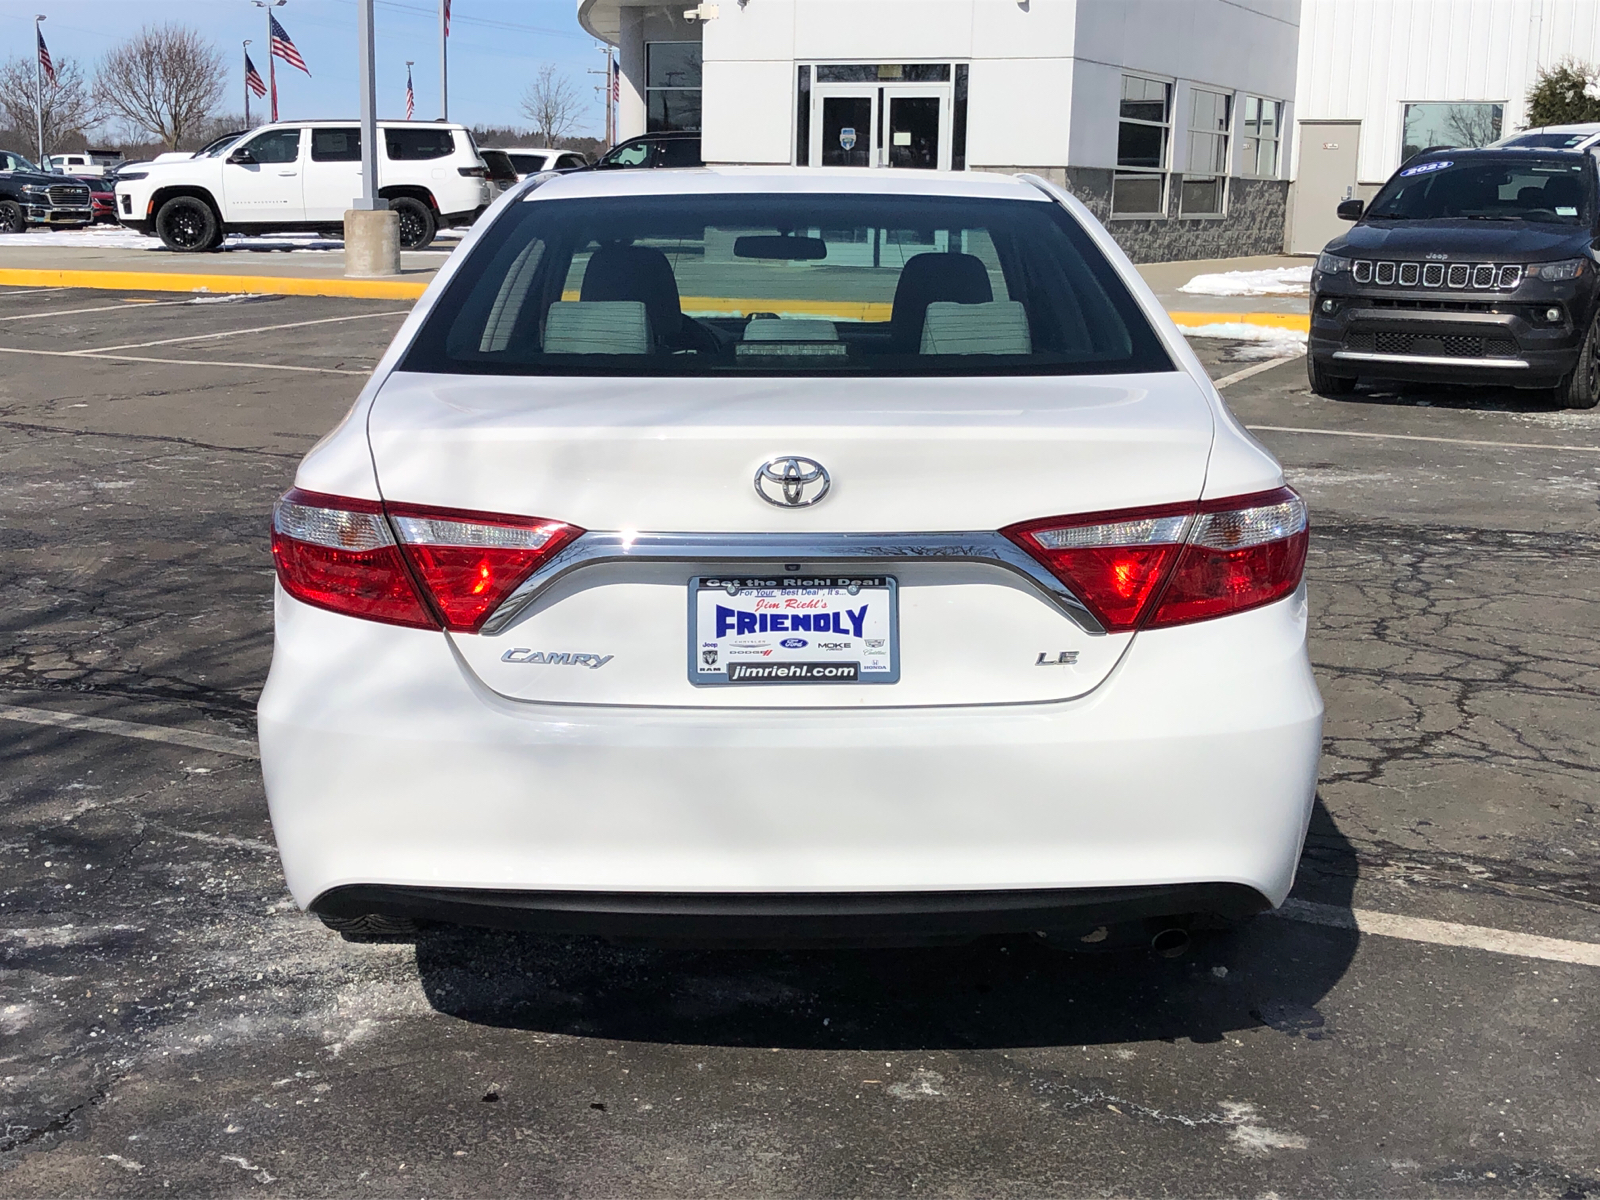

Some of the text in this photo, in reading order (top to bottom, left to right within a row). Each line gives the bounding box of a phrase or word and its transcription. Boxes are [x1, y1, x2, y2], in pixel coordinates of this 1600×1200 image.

[1408, 162, 1449, 175] 2023
[706, 578, 880, 587] Get the Riehl Deal
[755, 589, 776, 598] Your
[754, 598, 828, 612] Jim Riehl's
[716, 603, 869, 639] FRIENDLY
[500, 648, 614, 669] CAMRY
[1034, 651, 1080, 666] LE
[732, 665, 855, 680] jimriehl.com
